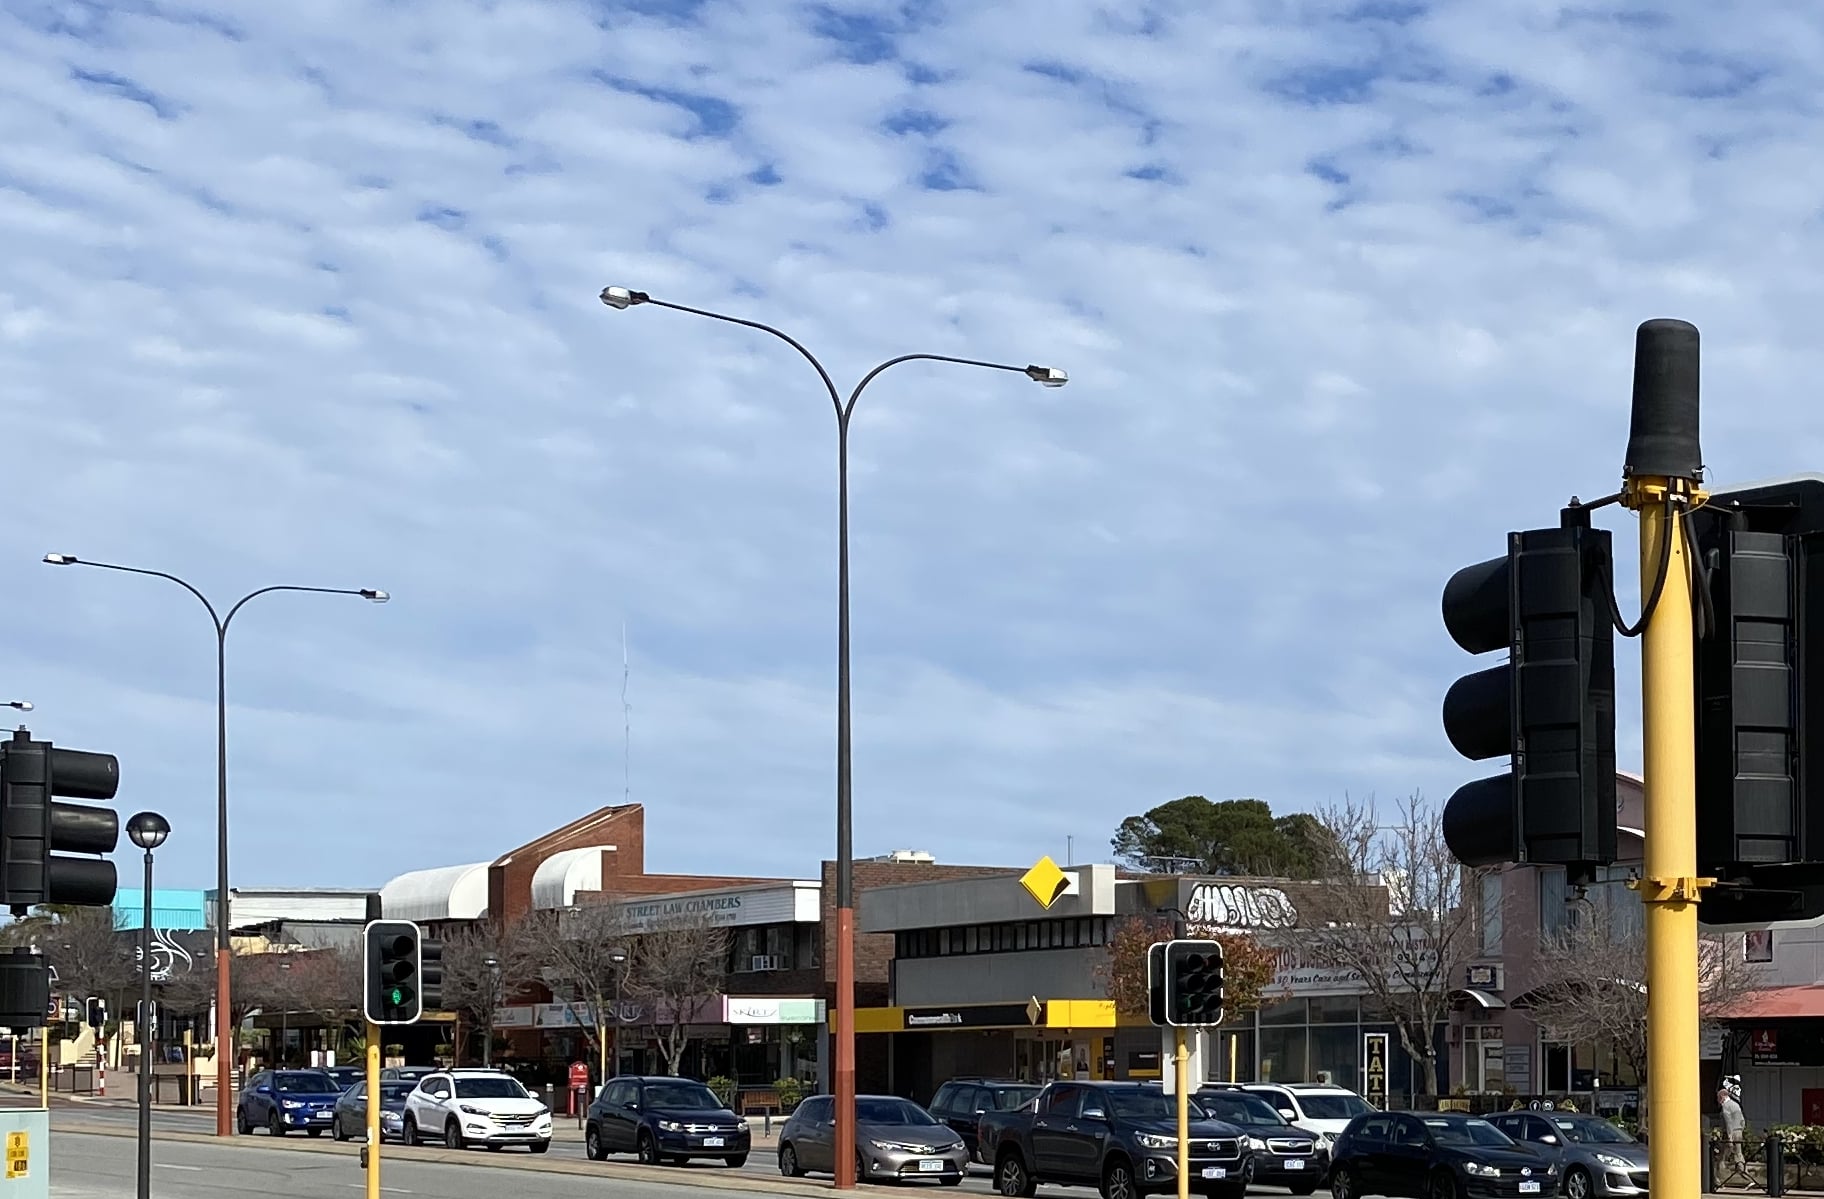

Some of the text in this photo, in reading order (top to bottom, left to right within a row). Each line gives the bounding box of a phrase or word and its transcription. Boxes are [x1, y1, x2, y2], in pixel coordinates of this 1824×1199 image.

[626, 896, 741, 918] STREET LAW CHAMBERS
